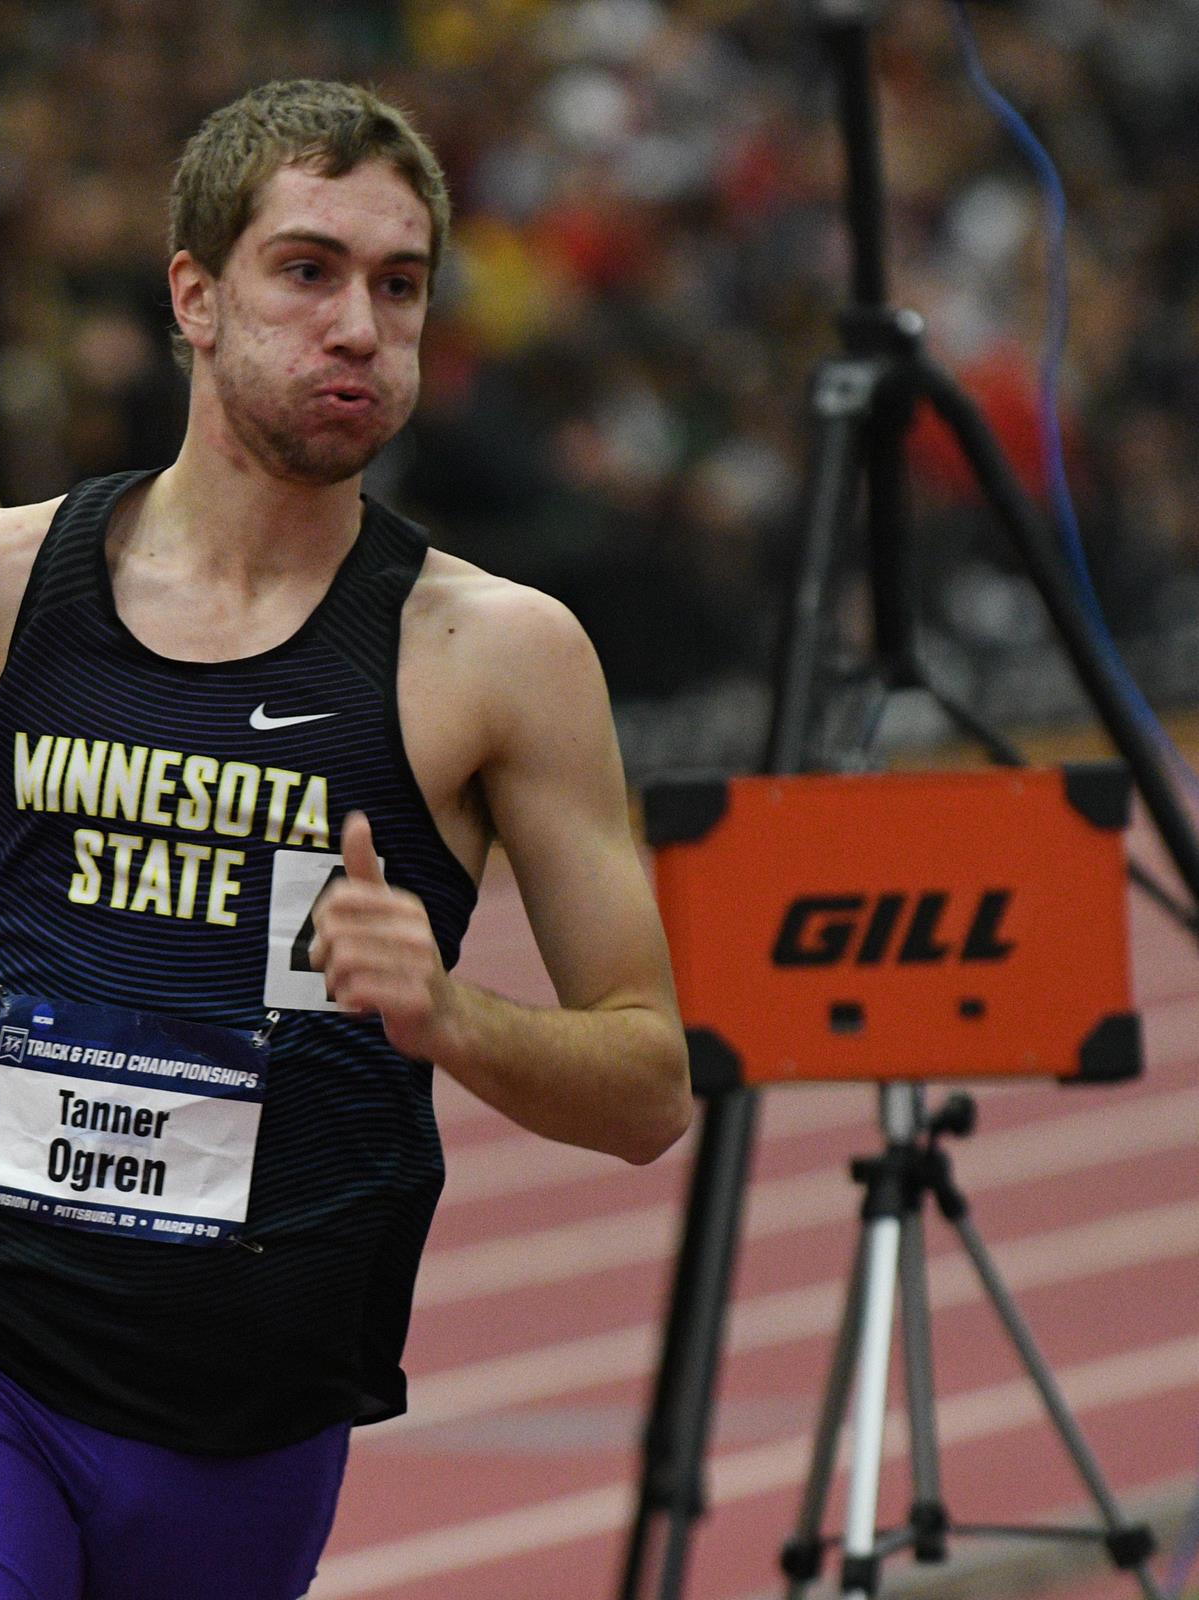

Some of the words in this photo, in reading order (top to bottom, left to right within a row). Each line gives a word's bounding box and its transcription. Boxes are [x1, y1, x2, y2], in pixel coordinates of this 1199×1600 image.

[14, 731, 330, 849] MINNESOTA
[68, 828, 245, 927] STATE
[771, 889, 1017, 968] GILL
[27, 1039, 71, 1061] TRACK
[82, 1048, 127, 1069] FIELD
[127, 1055, 260, 1089] CHAMPIONSHIPS
[58, 1089, 170, 1140] Tanner
[47, 1137, 167, 1197] Ogren
[29, 1198, 39, 1211] II
[53, 1204, 117, 1226] PITTSBURG,
[119, 1214, 136, 1227] KS
[152, 1218, 194, 1235] MARCH
[194, 1224, 221, 1238] 9-10
